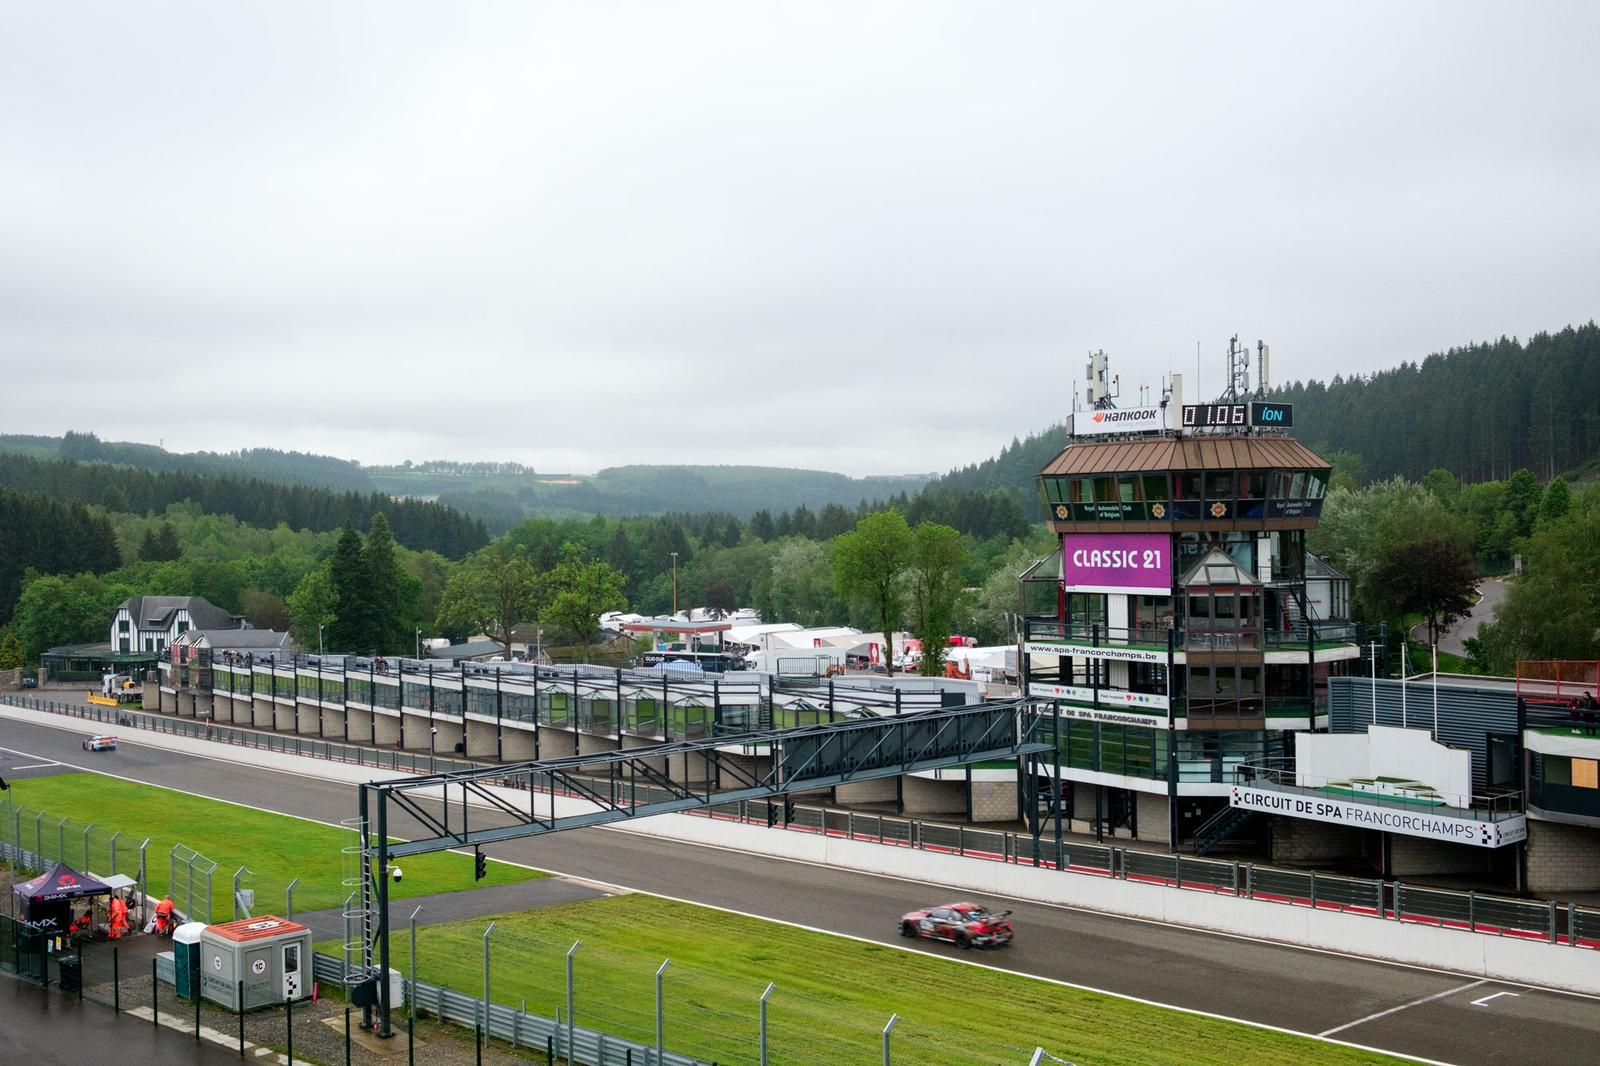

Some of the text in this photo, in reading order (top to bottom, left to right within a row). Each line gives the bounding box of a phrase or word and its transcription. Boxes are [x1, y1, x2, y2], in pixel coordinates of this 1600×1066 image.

[1073, 549, 1161, 569] CLASSIC 21
[1030, 645, 1157, 660] www.spa-francorchamps.be
[1078, 711, 1092, 719] SPA
[1094, 713, 1158, 726] FRANCORCHAMPS
[1244, 792, 1475, 838] CIRCUIT DE SPA FRANCORCHAMPS
